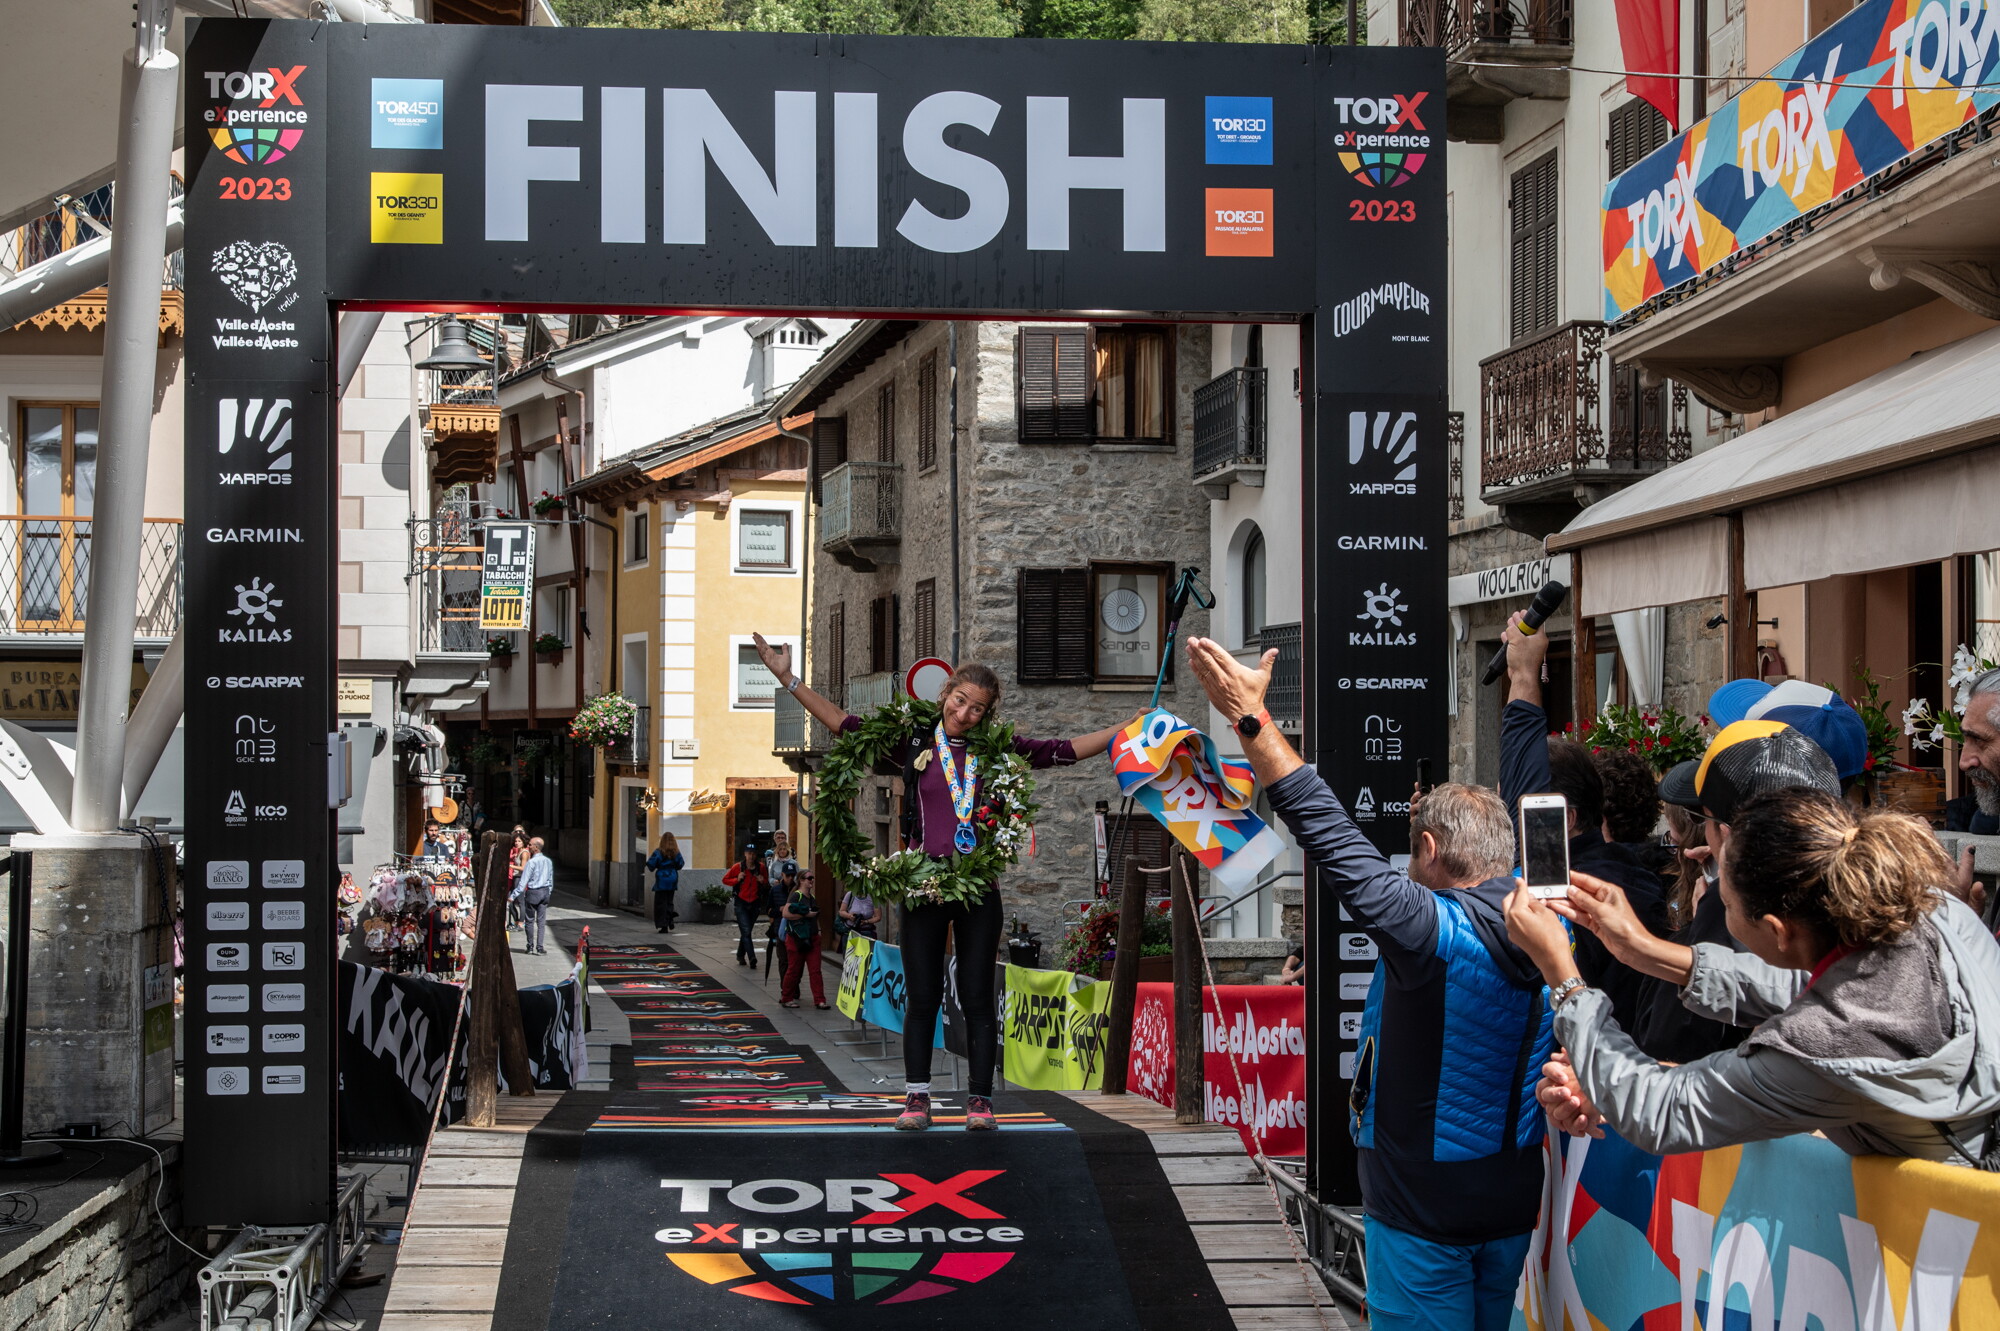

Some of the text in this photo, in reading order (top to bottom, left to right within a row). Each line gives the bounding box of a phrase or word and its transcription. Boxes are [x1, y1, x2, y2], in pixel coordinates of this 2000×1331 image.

[204, 65, 308, 108] TORX
[204, 106, 308, 126] eXperience
[376, 101, 438, 115] TOR450
[1334, 91, 1430, 133] TORX
[1212, 118, 1266, 132] TOR130
[1740, 43, 1843, 200] TORX
[1334, 130, 1430, 150] eXperience
[485, 84, 1166, 254] FINISH
[219, 177, 292, 201] 2023
[376, 195, 438, 209] TOR330
[1349, 199, 1417, 222] 2023
[1627, 138, 1707, 270] TORX
[1215, 210, 1264, 223] TOR30
[1333, 281, 1430, 338] COURMAYEUR
[216, 316, 295, 333] Valle d'Aosta
[212, 333, 299, 350] Vallée d'Aoste
[219, 473, 292, 485] KARPOS
[1349, 483, 1416, 494] KARPOS
[492, 529, 521, 565] T
[485, 571, 525, 580] TABACCHI
[1478, 558, 1552, 598] WOOLRICH
[483, 598, 522, 621] LOTTO
[219, 628, 293, 643] KAILAS
[1349, 632, 1417, 646] KAILAS
[11, 671, 80, 685] BUREA
[660, 1169, 1008, 1225] TORX
[654, 1223, 1024, 1249] eXperience
